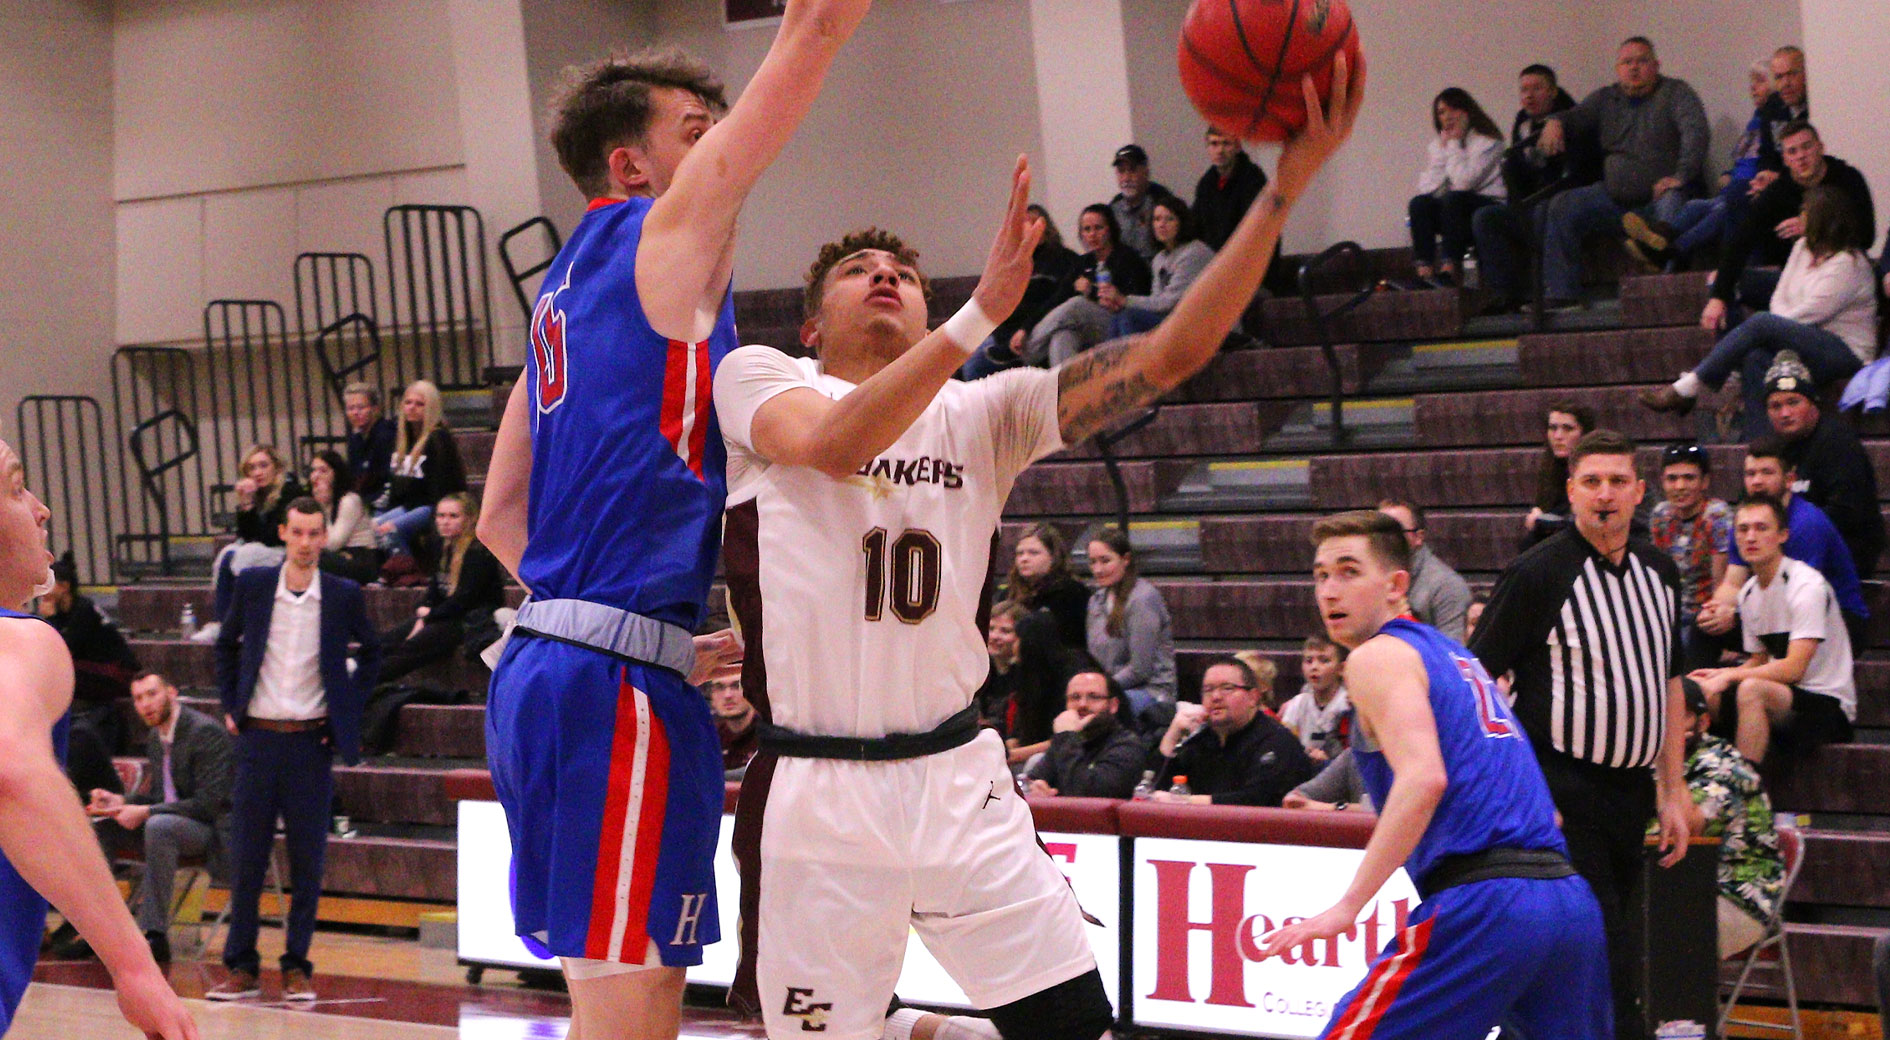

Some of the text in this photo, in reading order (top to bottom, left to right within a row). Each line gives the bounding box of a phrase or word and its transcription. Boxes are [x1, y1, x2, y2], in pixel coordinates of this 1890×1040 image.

[856, 456, 964, 489] AKERS
[862, 526, 942, 625] 10
[669, 893, 708, 946] H
[783, 986, 833, 1032] EC
[1263, 991, 1334, 1019] COLLEG
